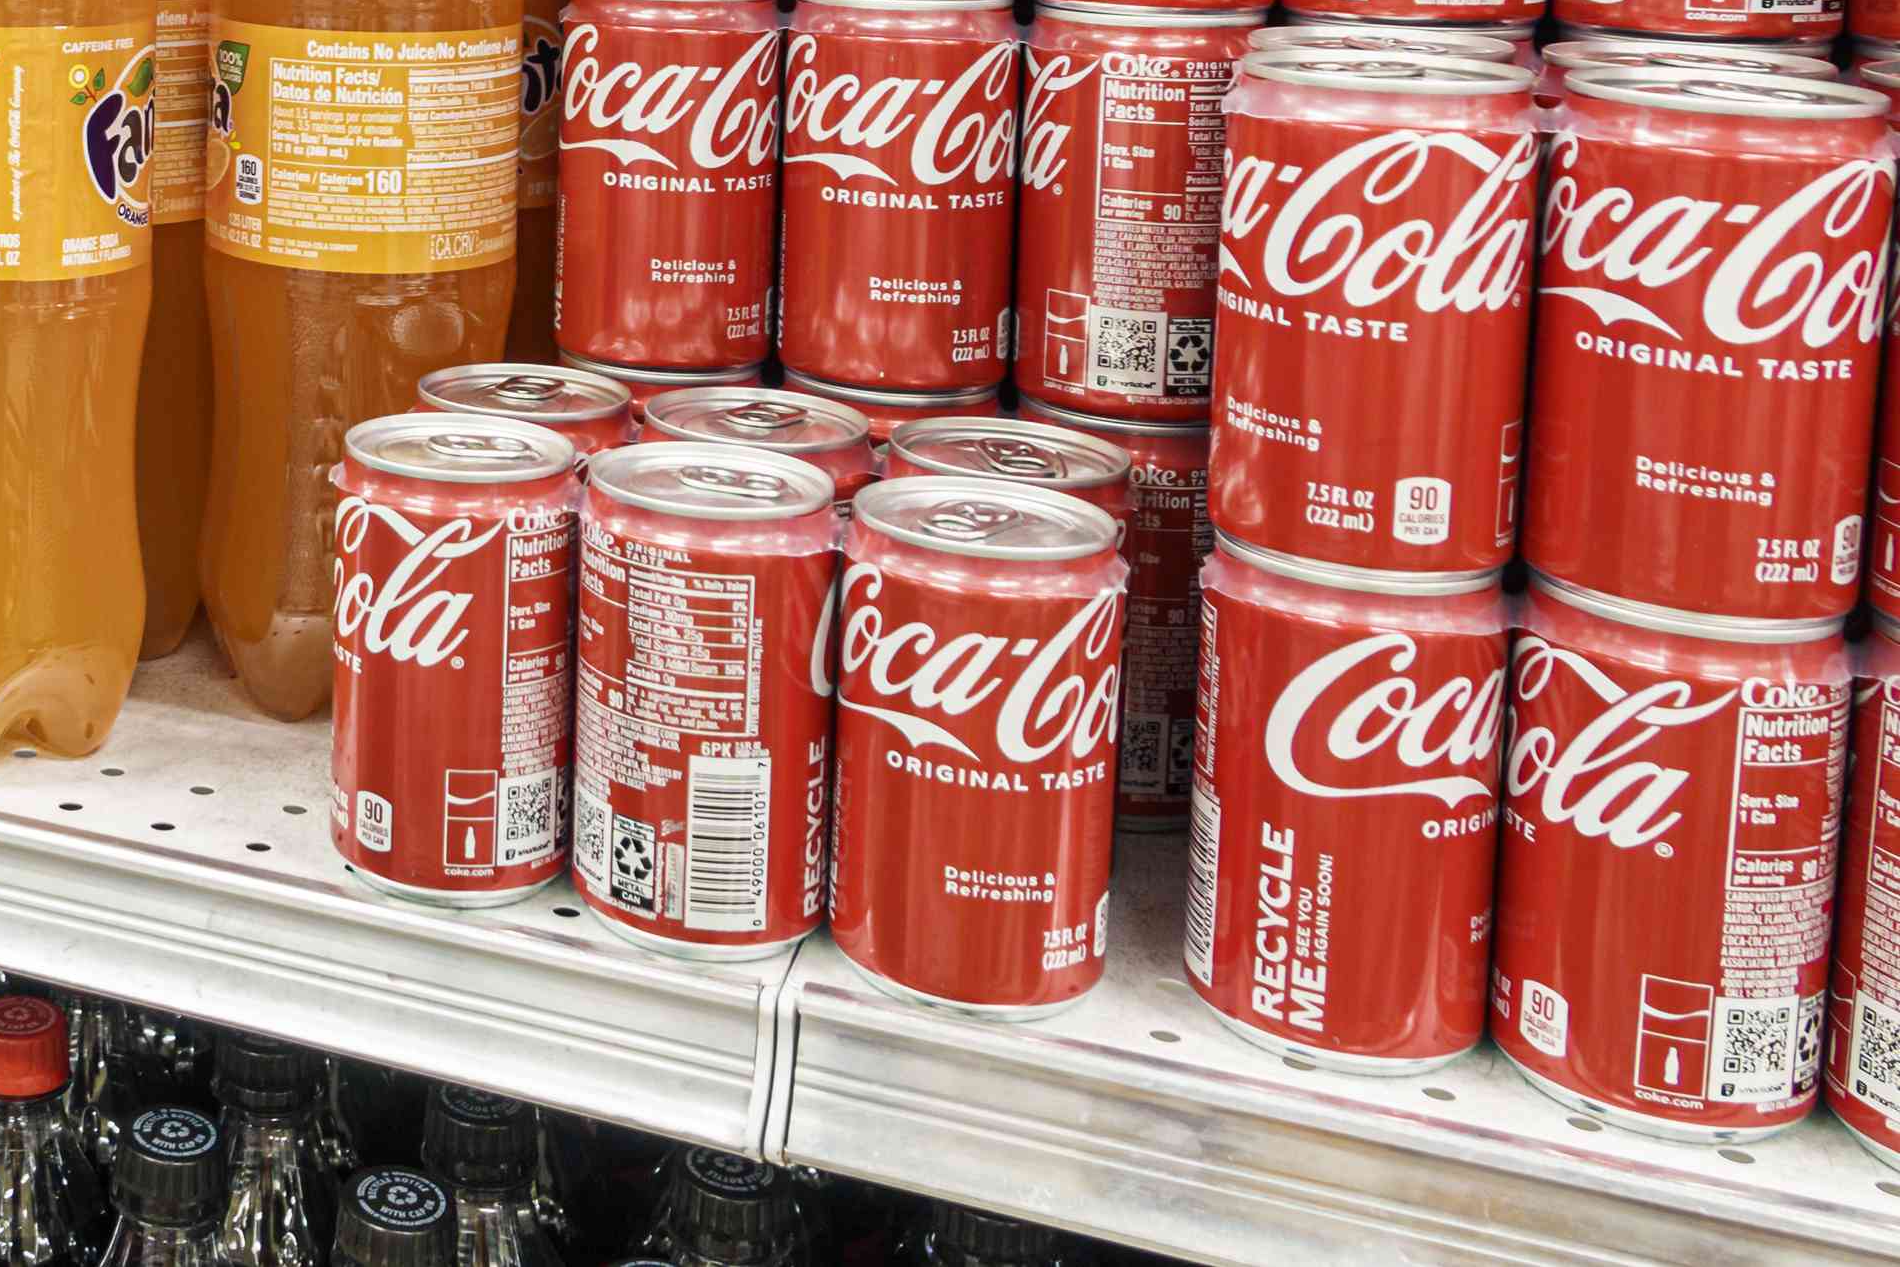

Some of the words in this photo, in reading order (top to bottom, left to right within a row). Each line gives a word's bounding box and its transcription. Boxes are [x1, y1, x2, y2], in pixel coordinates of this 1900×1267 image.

[62, 40, 113, 55] CAFFEINE
[219, 49, 244, 65] 100%
[307, 40, 370, 60] Contains
[374, 43, 393, 61] No
[397, 43, 456, 61] Juice/No
[458, 40, 501, 57] Contiene
[272, 63, 331, 85] Nutrition
[336, 67, 381, 87] Facts/
[1101, 51, 1172, 79] Coke
[272, 82, 310, 102] Datos
[313, 86, 331, 103] de
[336, 86, 403, 105] Nutrición
[560, 23, 782, 169] Coca-Co
[1104, 79, 1185, 102] Nutrition
[786, 34, 1016, 185] Coca-Co
[1104, 99, 1156, 121] Facts
[273, 145, 284, 154] 12
[240, 159, 257, 176] 160
[365, 170, 401, 194] 160
[603, 171, 716, 192] ORIGINAL
[723, 173, 773, 192] TASTE
[821, 187, 939, 210] ORIGINAL
[949, 191, 1005, 210] TASTE
[1101, 194, 1153, 211] Calories
[1163, 204, 1181, 222] 90
[117, 203, 149, 226] ORANGE
[1223, 131, 1535, 314] a-Cola
[1541, 133, 1897, 350] Coca-Col
[650, 258, 725, 271] Delicious
[651, 271, 736, 284] Refreshing
[869, 276, 948, 291] Delicious
[869, 289, 961, 306] Refreshing
[1304, 312, 1409, 343] TASTE
[1575, 330, 1745, 378] ORIGINAL
[1758, 357, 1854, 380] TASTE
[1228, 395, 1302, 431] Delicious
[1307, 418, 1322, 435] &
[1227, 411, 1320, 452] Refreshing
[1130, 465, 1178, 486] oke
[1635, 455, 1753, 487] Delicious
[1410, 485, 1439, 511] 90
[1635, 471, 1774, 507] Refreshing
[507, 506, 561, 534] Coke
[1399, 512, 1446, 526] CALORIES
[511, 532, 569, 557] Nutrition
[626, 542, 692, 564] ORIGINAL
[511, 559, 552, 578] Facts
[334, 496, 504, 668] ola
[518, 618, 536, 631] Can
[508, 655, 550, 673] Calories
[839, 561, 1121, 764] Coca-Co
[1740, 676, 1820, 709] Coke
[1745, 713, 1830, 738] Nutrition
[700, 741, 732, 758] 6PK
[1508, 636, 1739, 849] ola
[1743, 737, 1802, 763] Facts
[887, 749, 1029, 792] ORIGINAL
[1040, 761, 1106, 790] TASTE
[363, 798, 384, 823] 90
[1421, 805, 1499, 839] ORIGIN
[358, 818, 389, 838] CALORIES
[802, 736, 827, 917] RECYCLE
[444, 865, 495, 878] coke.com
[944, 865, 1039, 887] Delicious
[1734, 856, 1795, 875] Calories
[1317, 853, 1334, 903] SOON!
[945, 880, 1054, 904] Refreshing
[1298, 886, 1313, 923] YOU
[1252, 821, 1295, 1021] RECYCLE
[1296, 925, 1311, 958] SEE
[1315, 906, 1331, 962] AGAIN
[1289, 959, 1327, 1031] ME
[1532, 989, 1556, 1022] 90
[1634, 1090, 1705, 1110] coke.com
[152, 1137, 176, 1149] WITH
[177, 1141, 196, 1151] CAP
[380, 1206, 406, 1219] WITH
[408, 1208, 427, 1220] CAP
